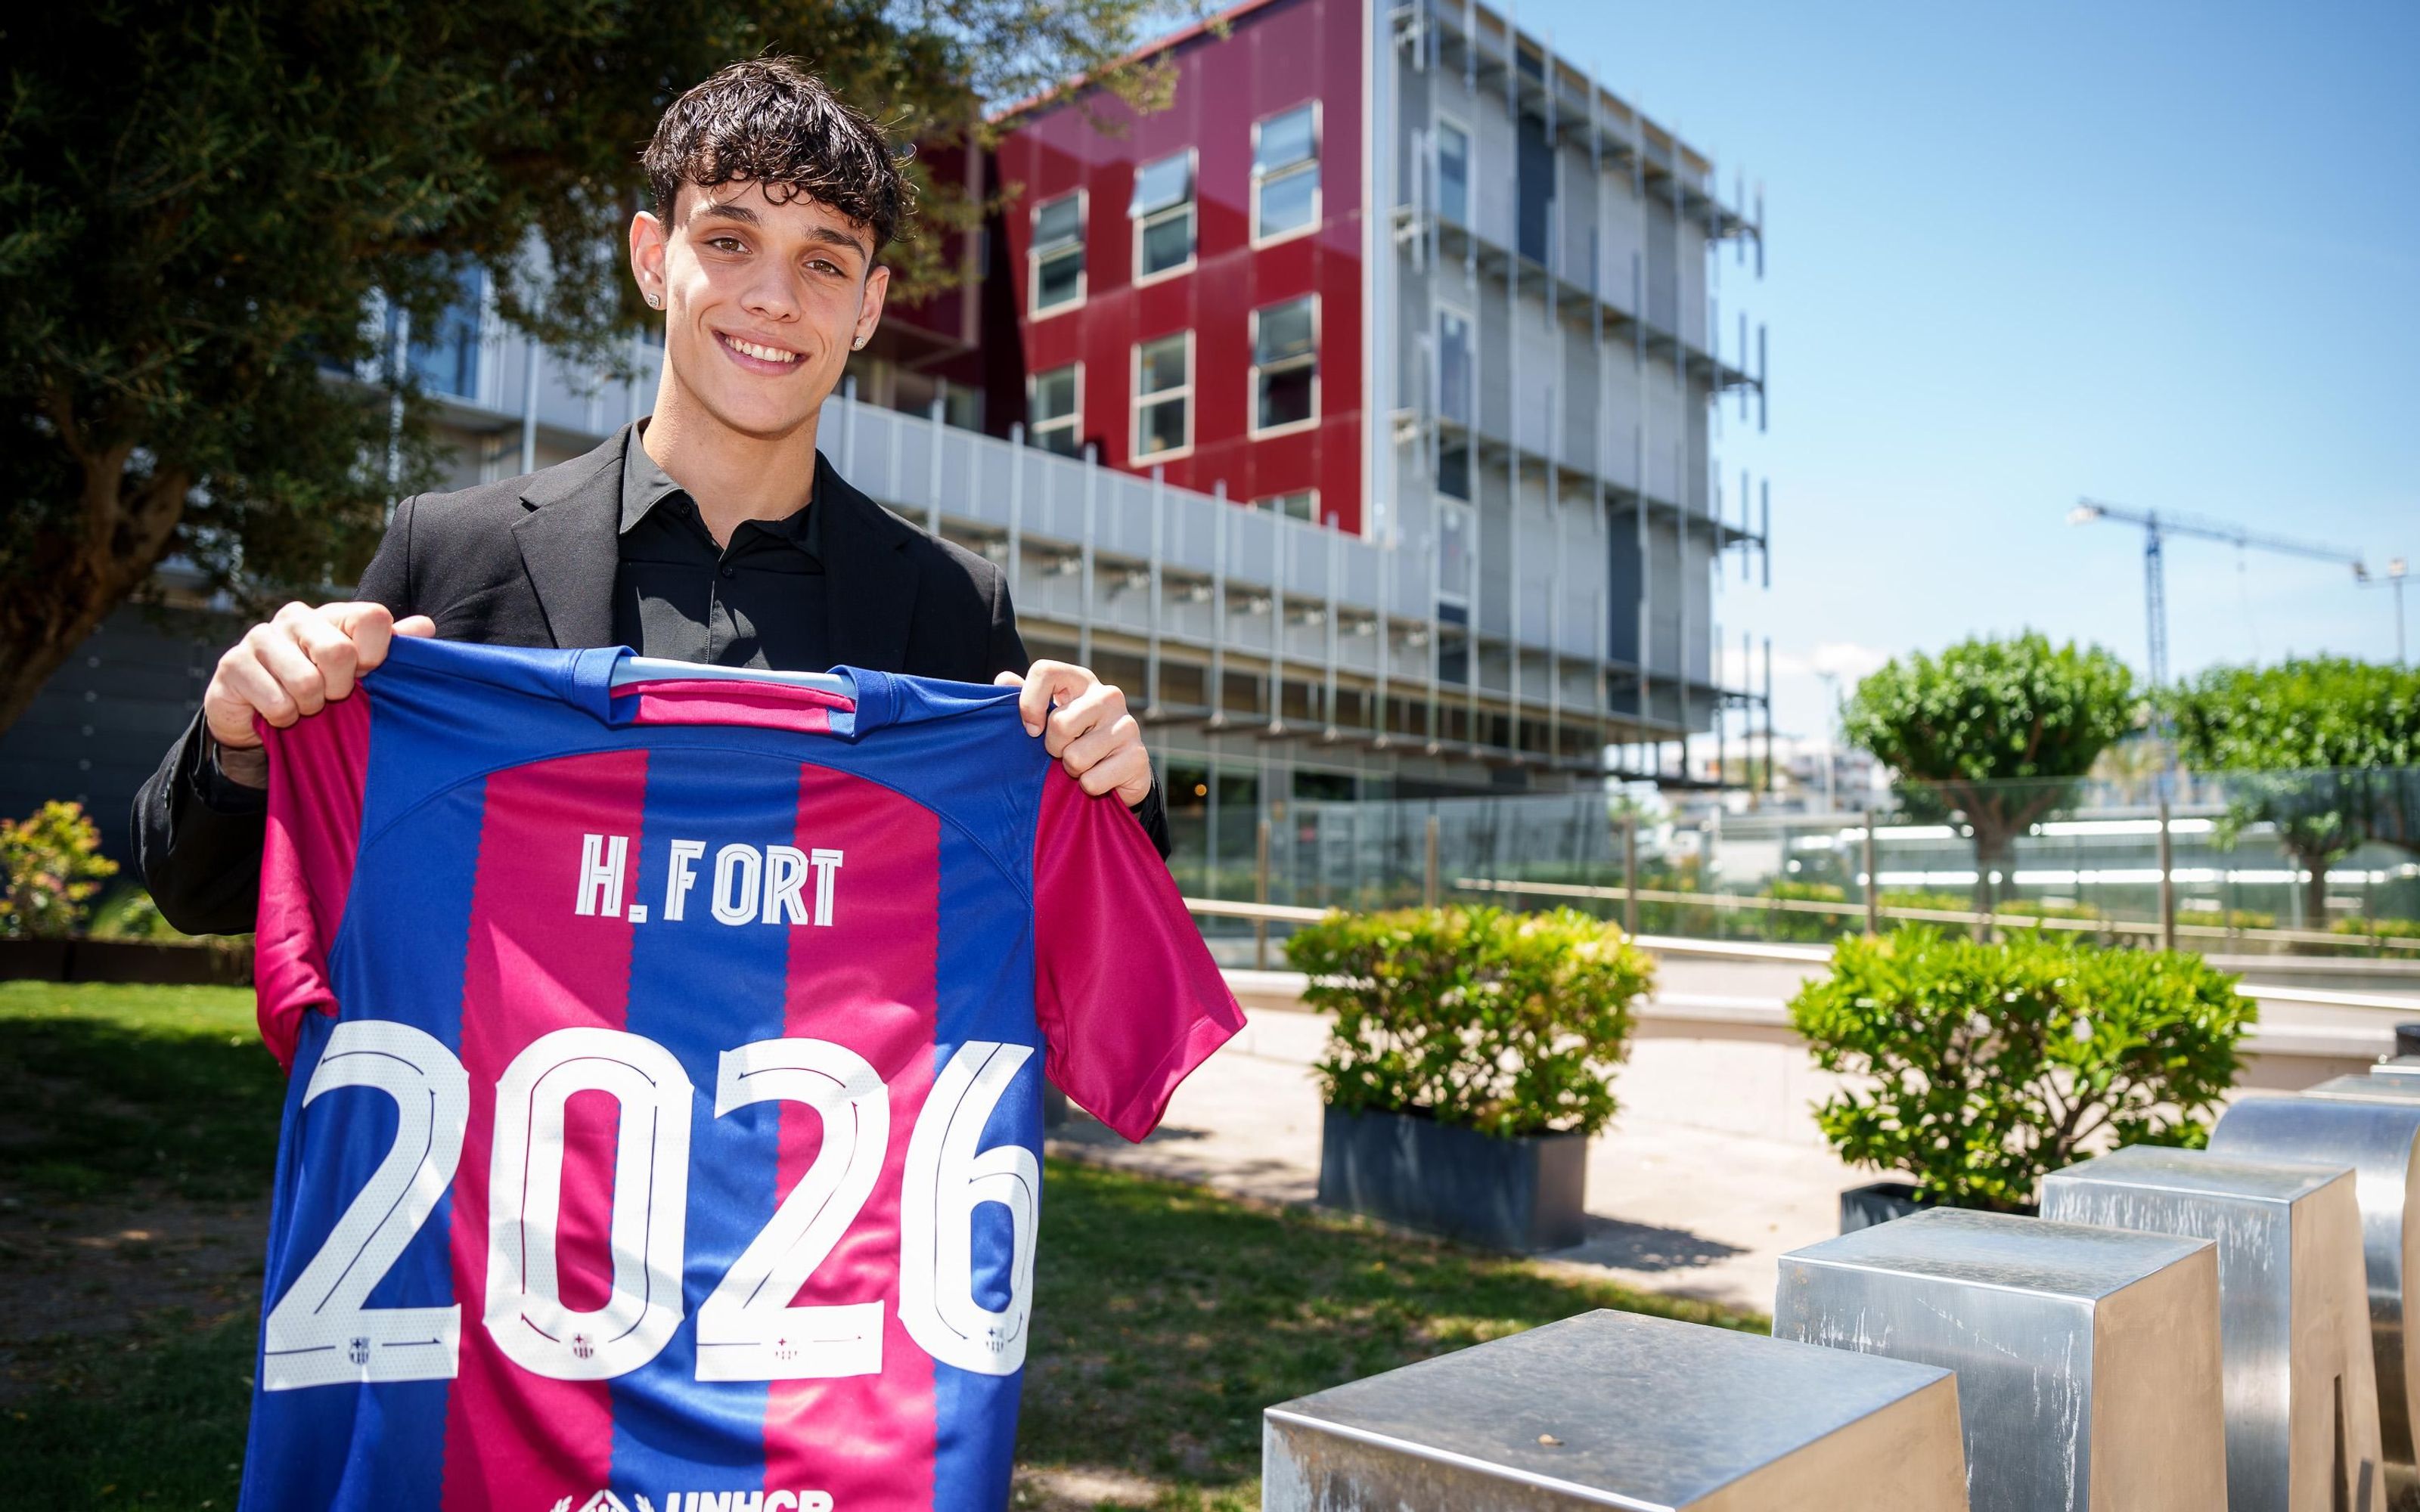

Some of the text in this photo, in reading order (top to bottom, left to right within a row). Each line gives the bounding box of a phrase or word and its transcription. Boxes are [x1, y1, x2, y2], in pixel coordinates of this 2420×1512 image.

[575, 833, 844, 927] H. FORT
[263, 1018, 1041, 1391] 2026
[666, 1489, 834, 1512] UNHCR
